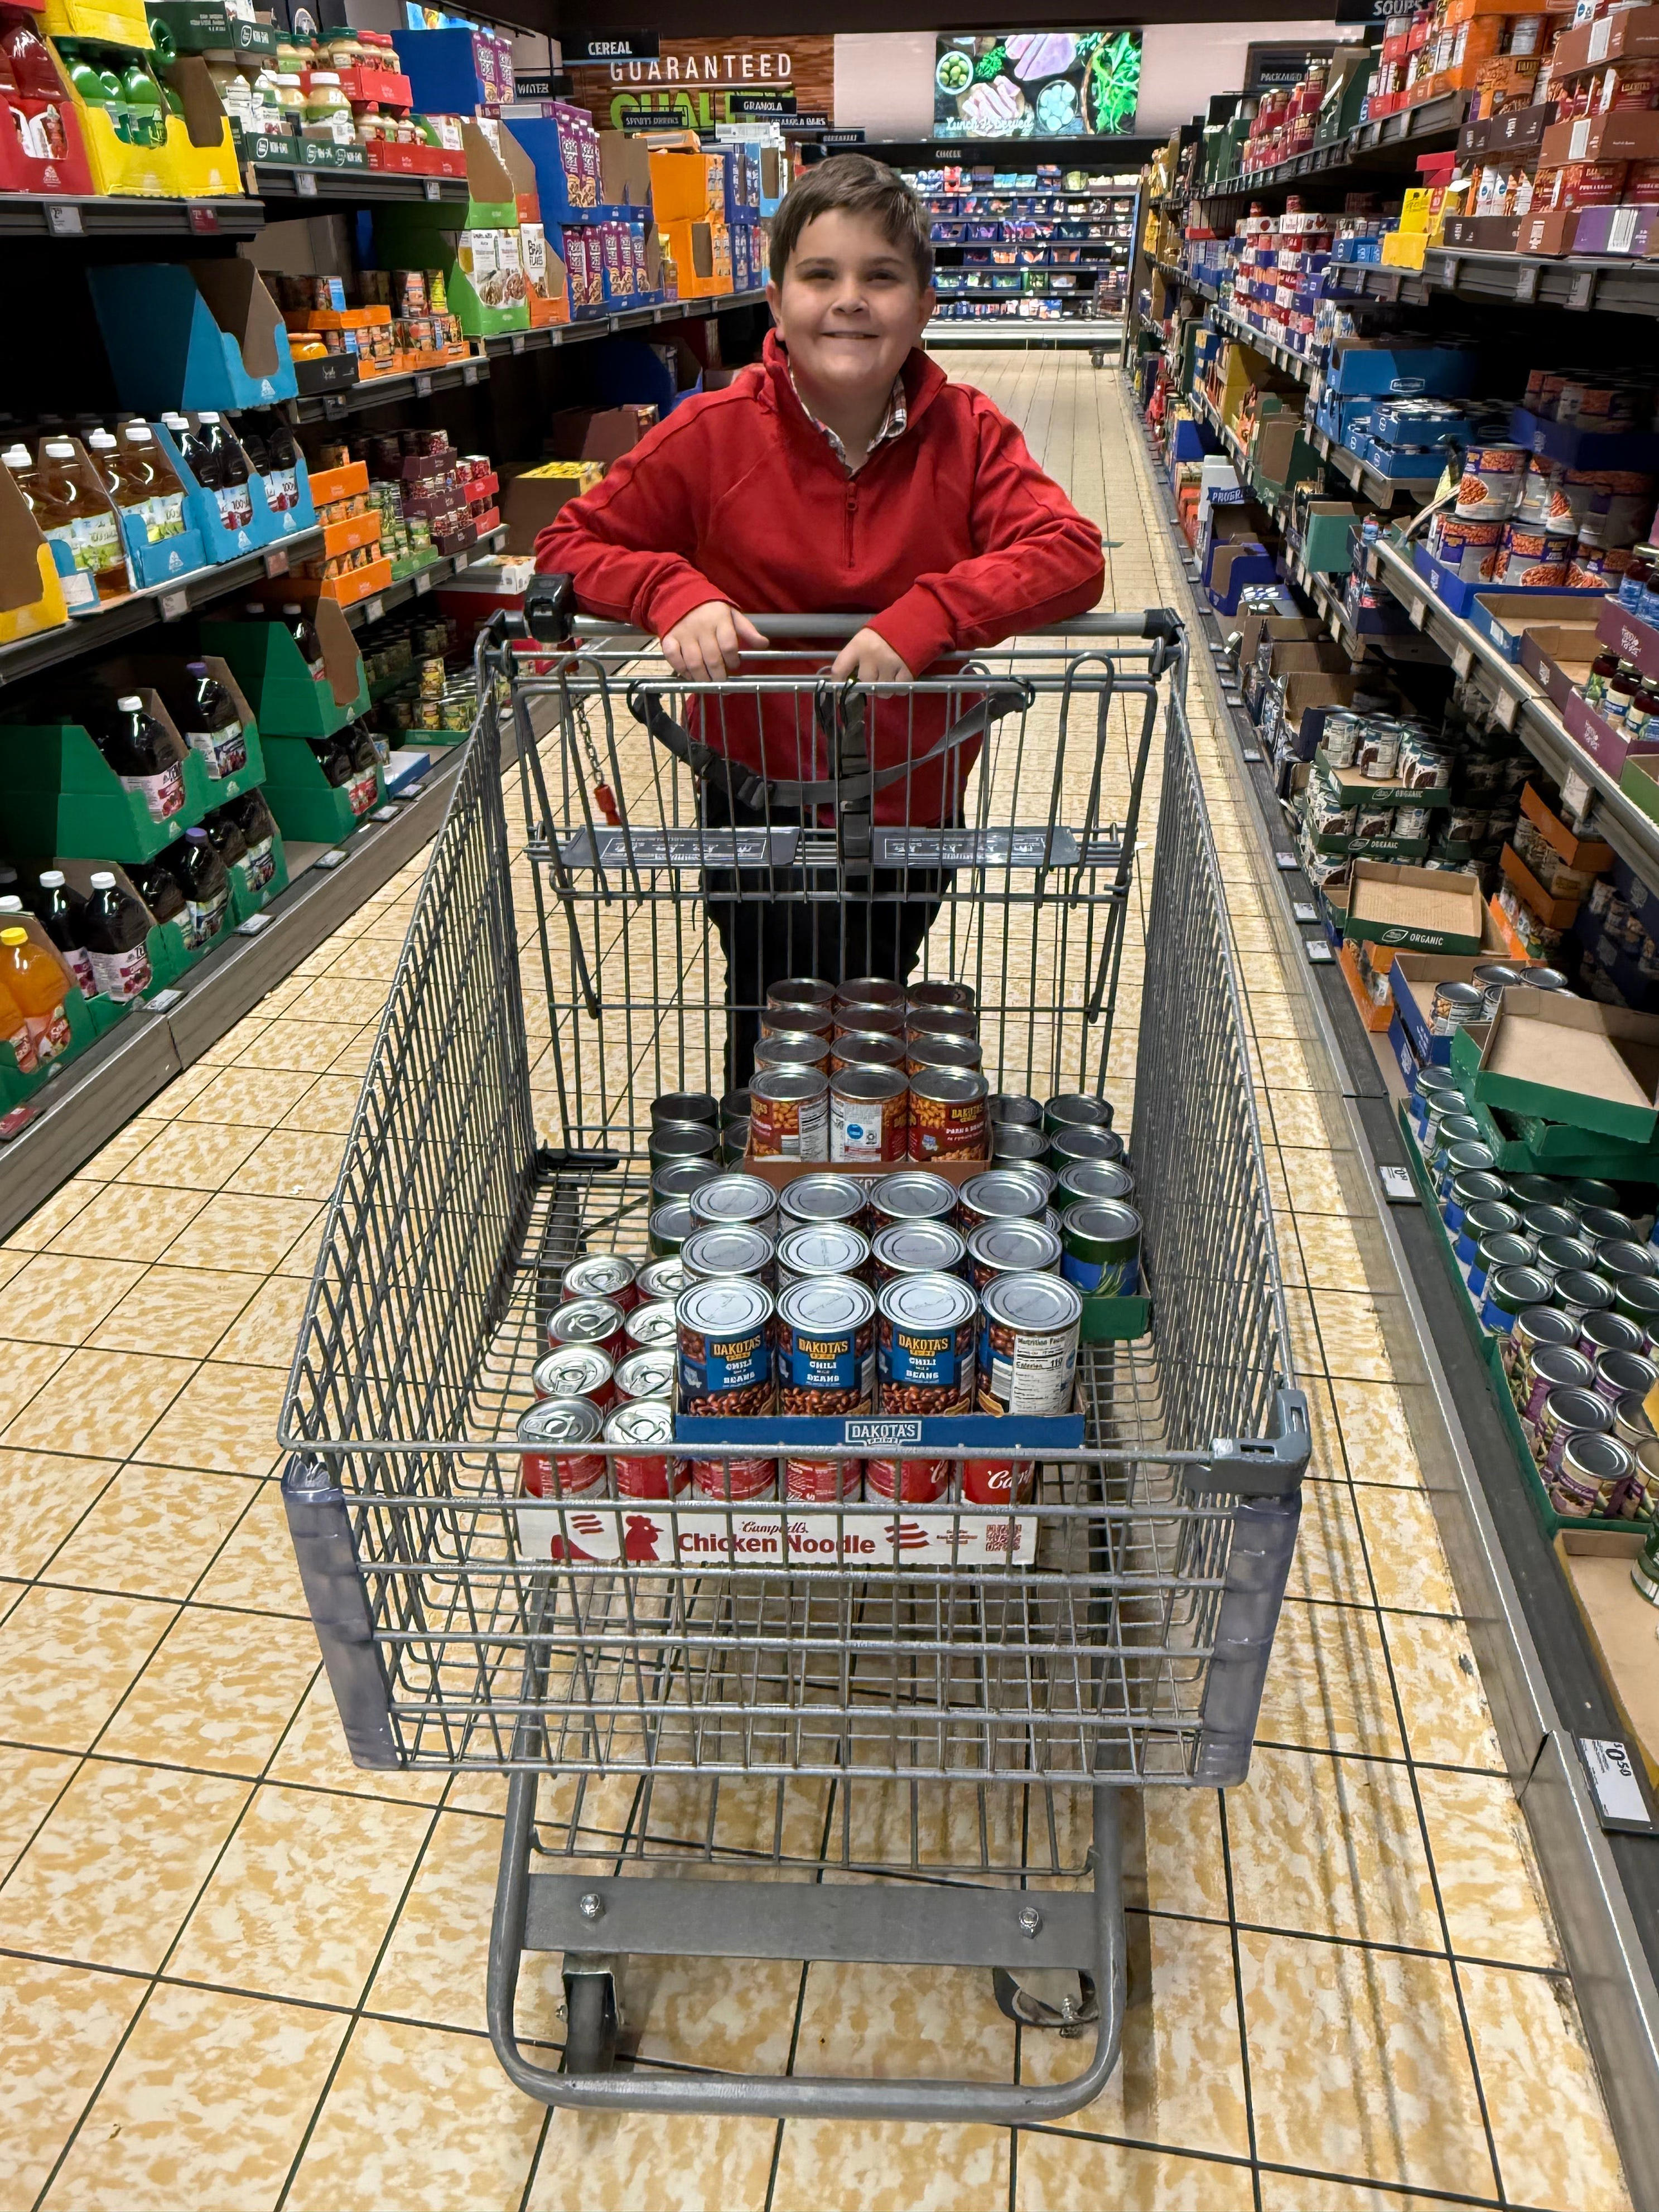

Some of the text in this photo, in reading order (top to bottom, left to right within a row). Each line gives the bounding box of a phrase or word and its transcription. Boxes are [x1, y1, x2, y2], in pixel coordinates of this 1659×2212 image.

[588, 41, 632, 55] CEREAL
[611, 54, 792, 81] GUARANTEED
[744, 101, 783, 111] GRANOLA
[946, 117, 978, 131] Lunch
[1410, 934, 1444, 945] ORGANIC
[713, 1335, 761, 1356] DAKOTA'S
[798, 1338, 848, 1353] DAKOTA'S
[899, 1334, 948, 1351] DAKOTA'S
[726, 1359, 752, 1370] CHILI
[909, 1357, 936, 1365] CHILI
[724, 1371, 755, 1384] BEANS
[807, 1374, 839, 1382] BEANS
[906, 1370, 939, 1379] BEANS
[852, 1424, 915, 1438] DAKOTA'S
[678, 1533, 876, 1553] Chicken Noodle
